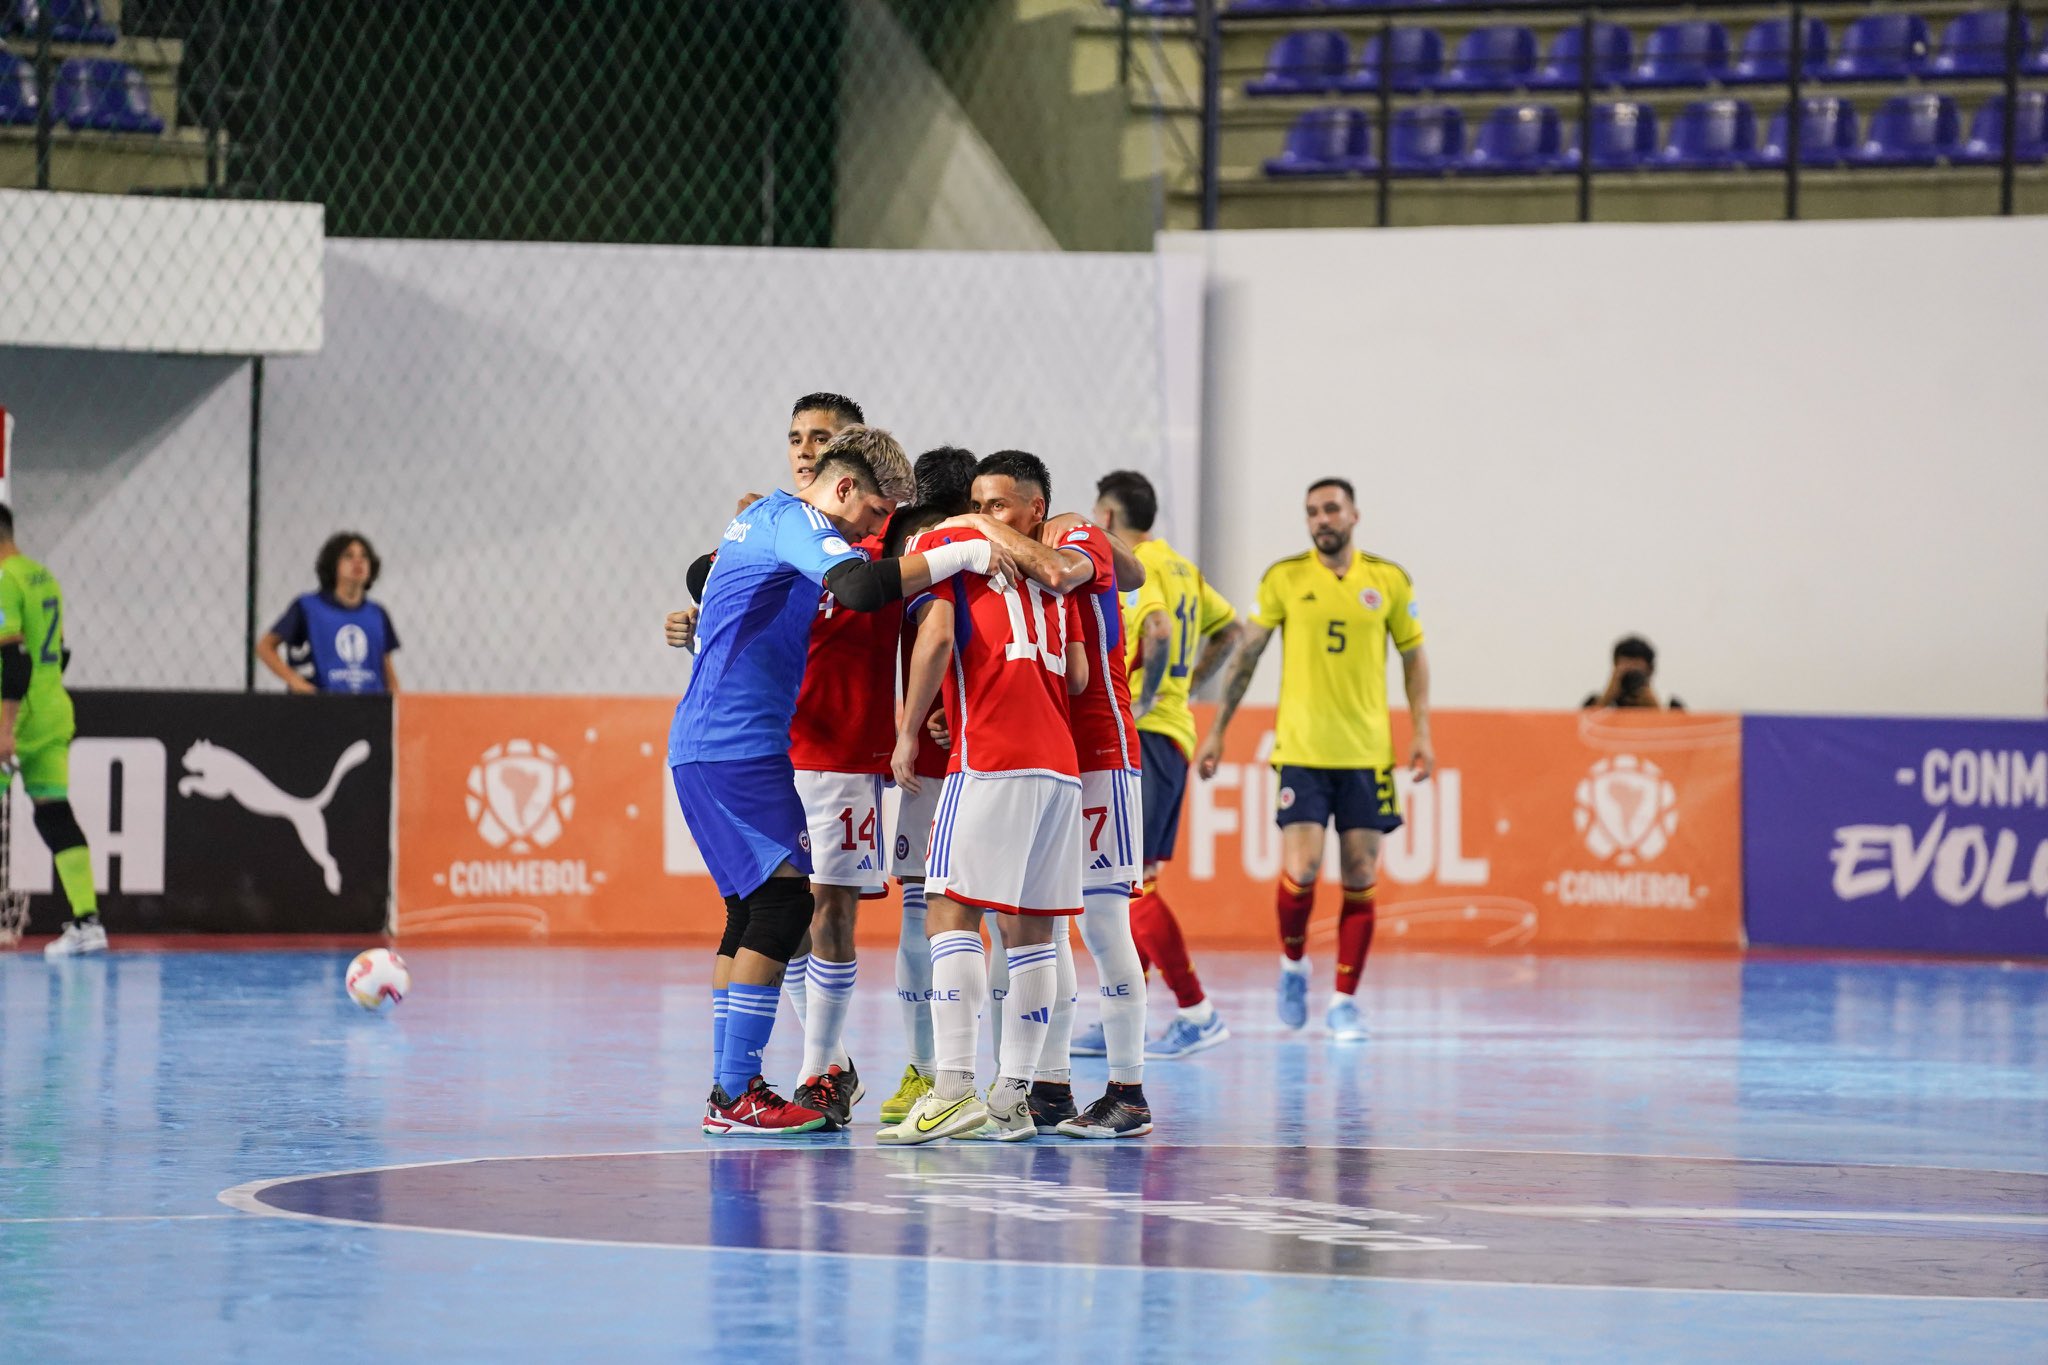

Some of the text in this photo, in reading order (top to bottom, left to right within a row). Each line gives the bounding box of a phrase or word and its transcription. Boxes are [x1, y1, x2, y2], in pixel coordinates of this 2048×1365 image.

[40, 597, 60, 664] 2
[987, 574, 1067, 677] 10
[1170, 594, 1198, 678] 11
[1326, 620, 1347, 654] 5
[1375, 765, 1394, 801] 5
[839, 807, 876, 851] 14
[1083, 806, 1107, 851] 7
[1189, 729, 1490, 885] FÚOL
[449, 860, 594, 896] CONMEBOL
[1557, 870, 1697, 910] CONMEBOL
[1100, 984, 1130, 997] ILE
